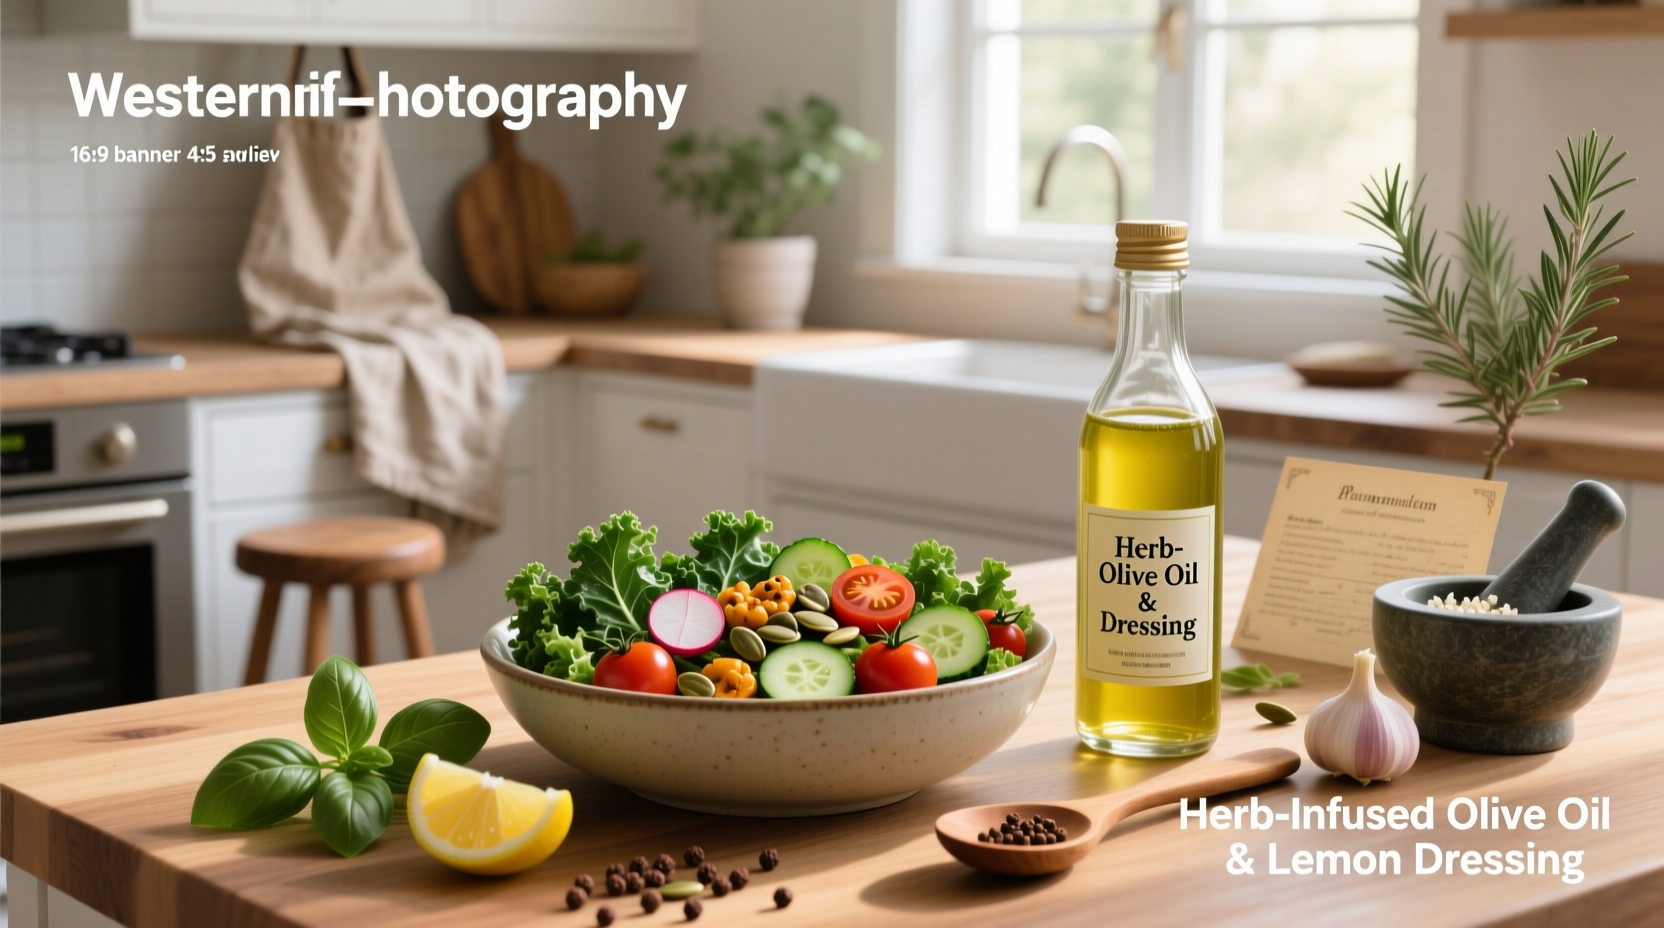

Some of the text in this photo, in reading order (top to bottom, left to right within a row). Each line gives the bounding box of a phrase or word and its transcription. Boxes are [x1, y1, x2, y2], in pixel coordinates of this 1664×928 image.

[1114, 535, 1184, 559] Herb-
[1099, 561, 1199, 587] Olive Oil
[1138, 591, 1157, 613] &
[1100, 610, 1197, 642] Dressing
